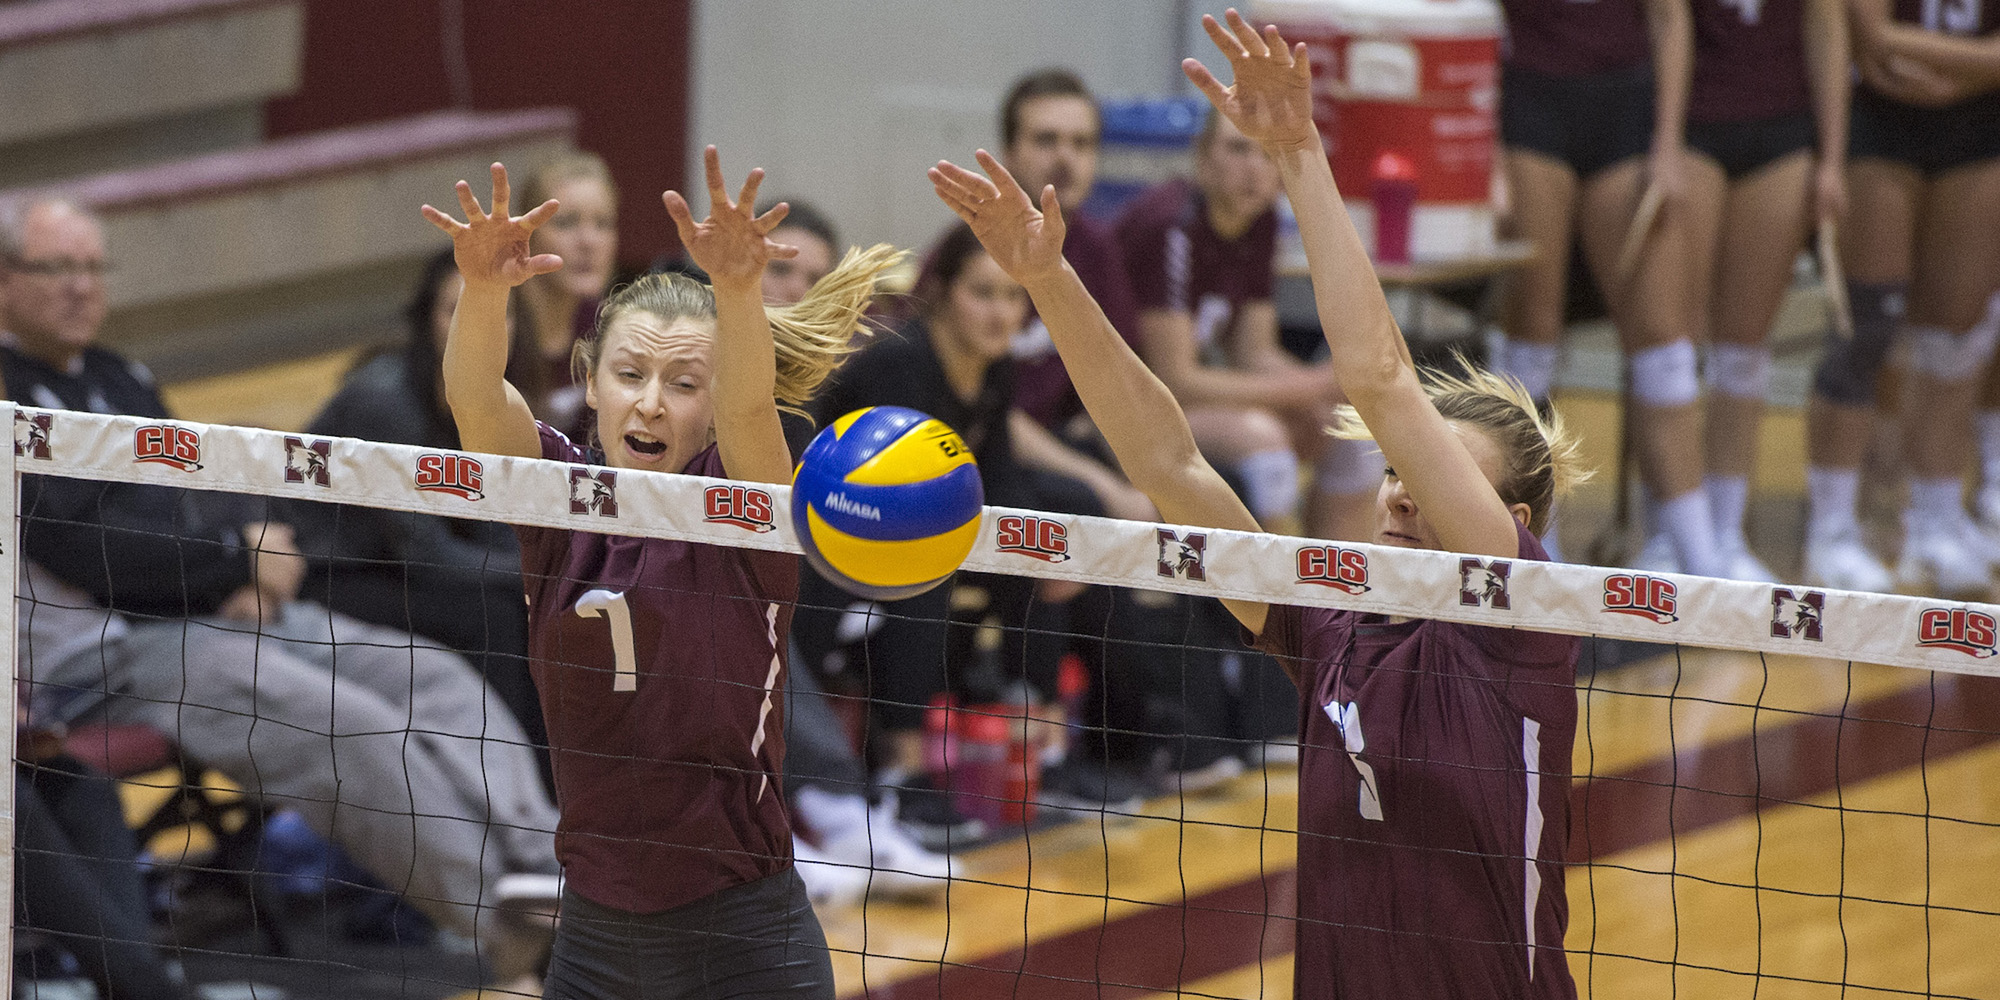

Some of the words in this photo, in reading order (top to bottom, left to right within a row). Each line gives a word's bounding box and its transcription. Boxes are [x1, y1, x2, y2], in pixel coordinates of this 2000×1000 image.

[135, 426, 200, 461] CIS
[415, 454, 483, 491] SIC
[703, 486, 773, 525] CIS
[997, 516, 1068, 554] SIC
[1296, 546, 1368, 585] CIS
[1603, 574, 1677, 616] SIC
[1918, 608, 1997, 648] CIS
